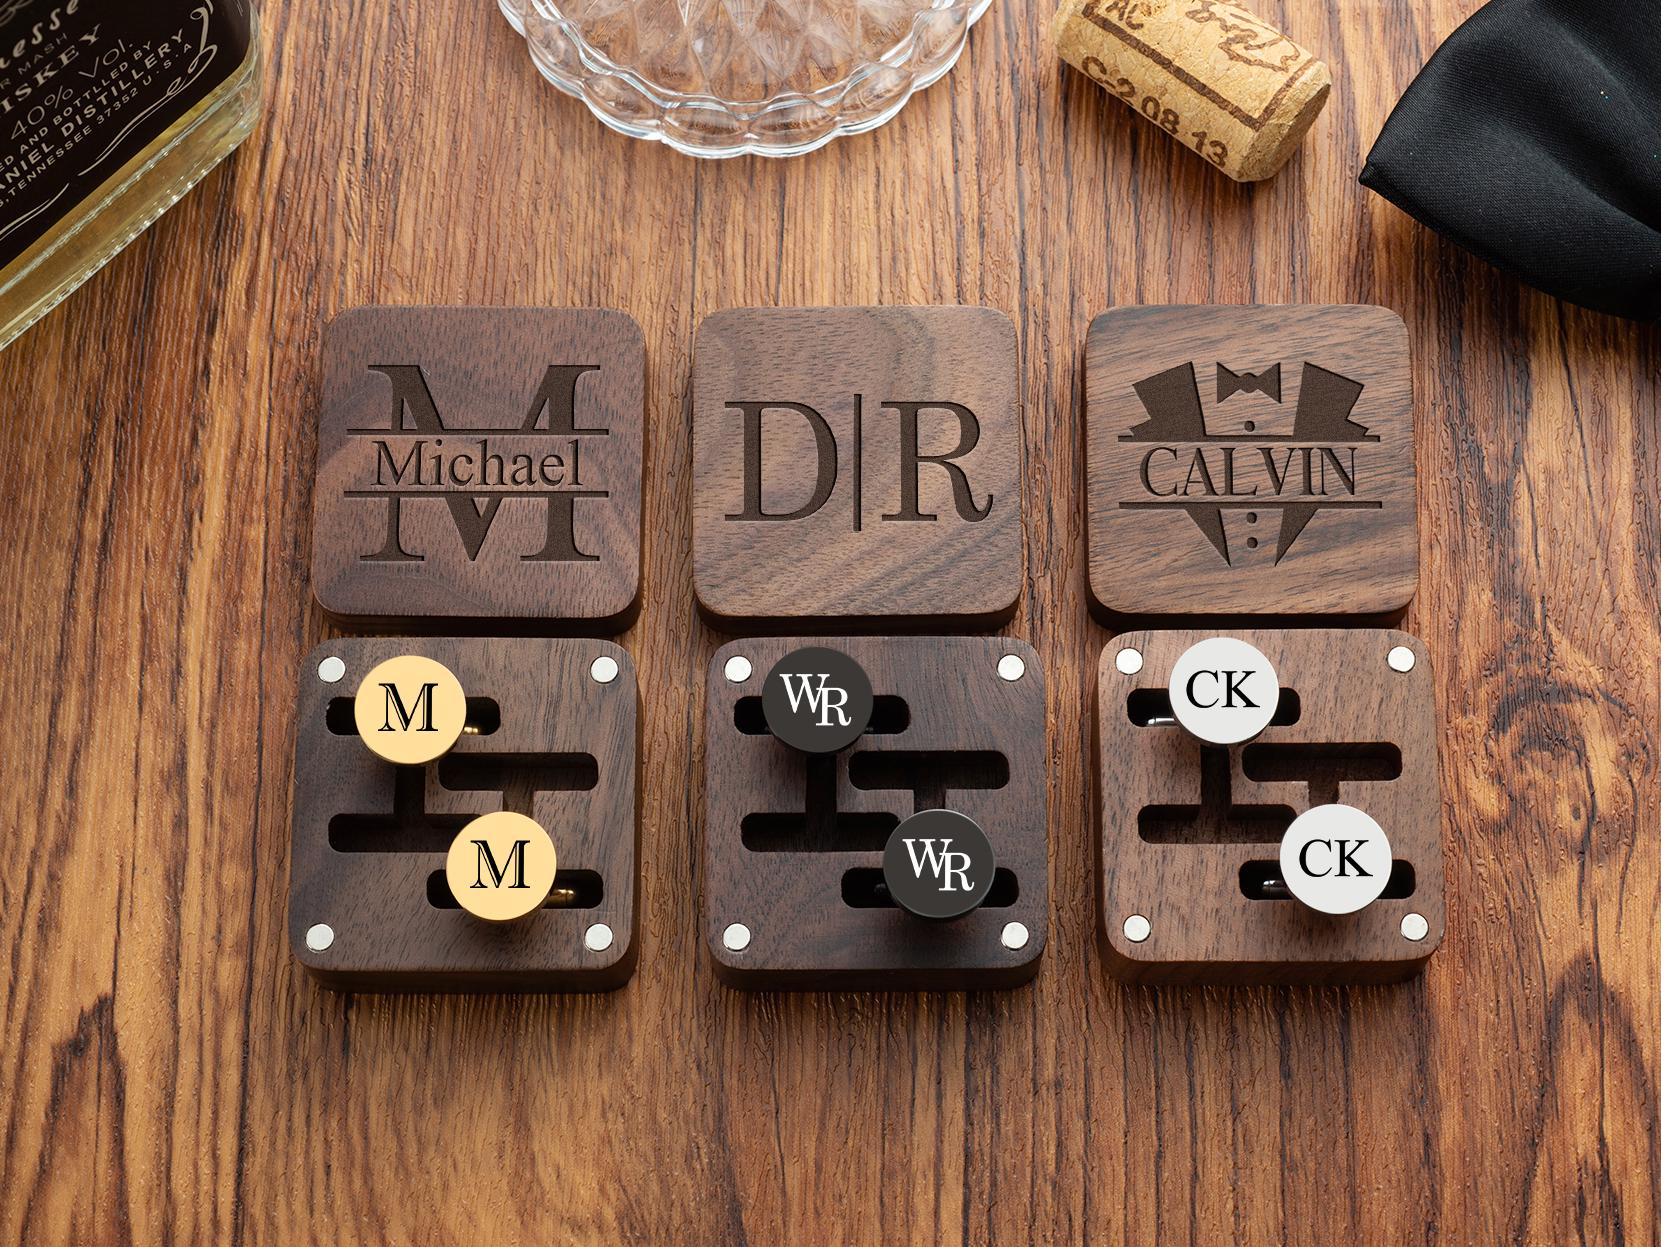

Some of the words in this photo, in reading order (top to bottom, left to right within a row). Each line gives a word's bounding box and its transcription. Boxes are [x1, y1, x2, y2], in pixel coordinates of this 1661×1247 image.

[18, 32, 67, 76] MASH
[20, 126, 48, 154] AND
[53, 61, 129, 126] BOTTLLED
[133, 41, 151, 61] BY
[61, 27, 183, 137] DISTILLERY
[96, 87, 138, 125] 37352
[11, 85, 73, 140] 40%
[370, 438, 584, 486] Michael
[1139, 447, 1358, 496] CALVIN
[378, 683, 439, 732] M
[1186, 670, 1260, 709] CK
[470, 840, 531, 889] M
[1299, 839, 1374, 878] CK
